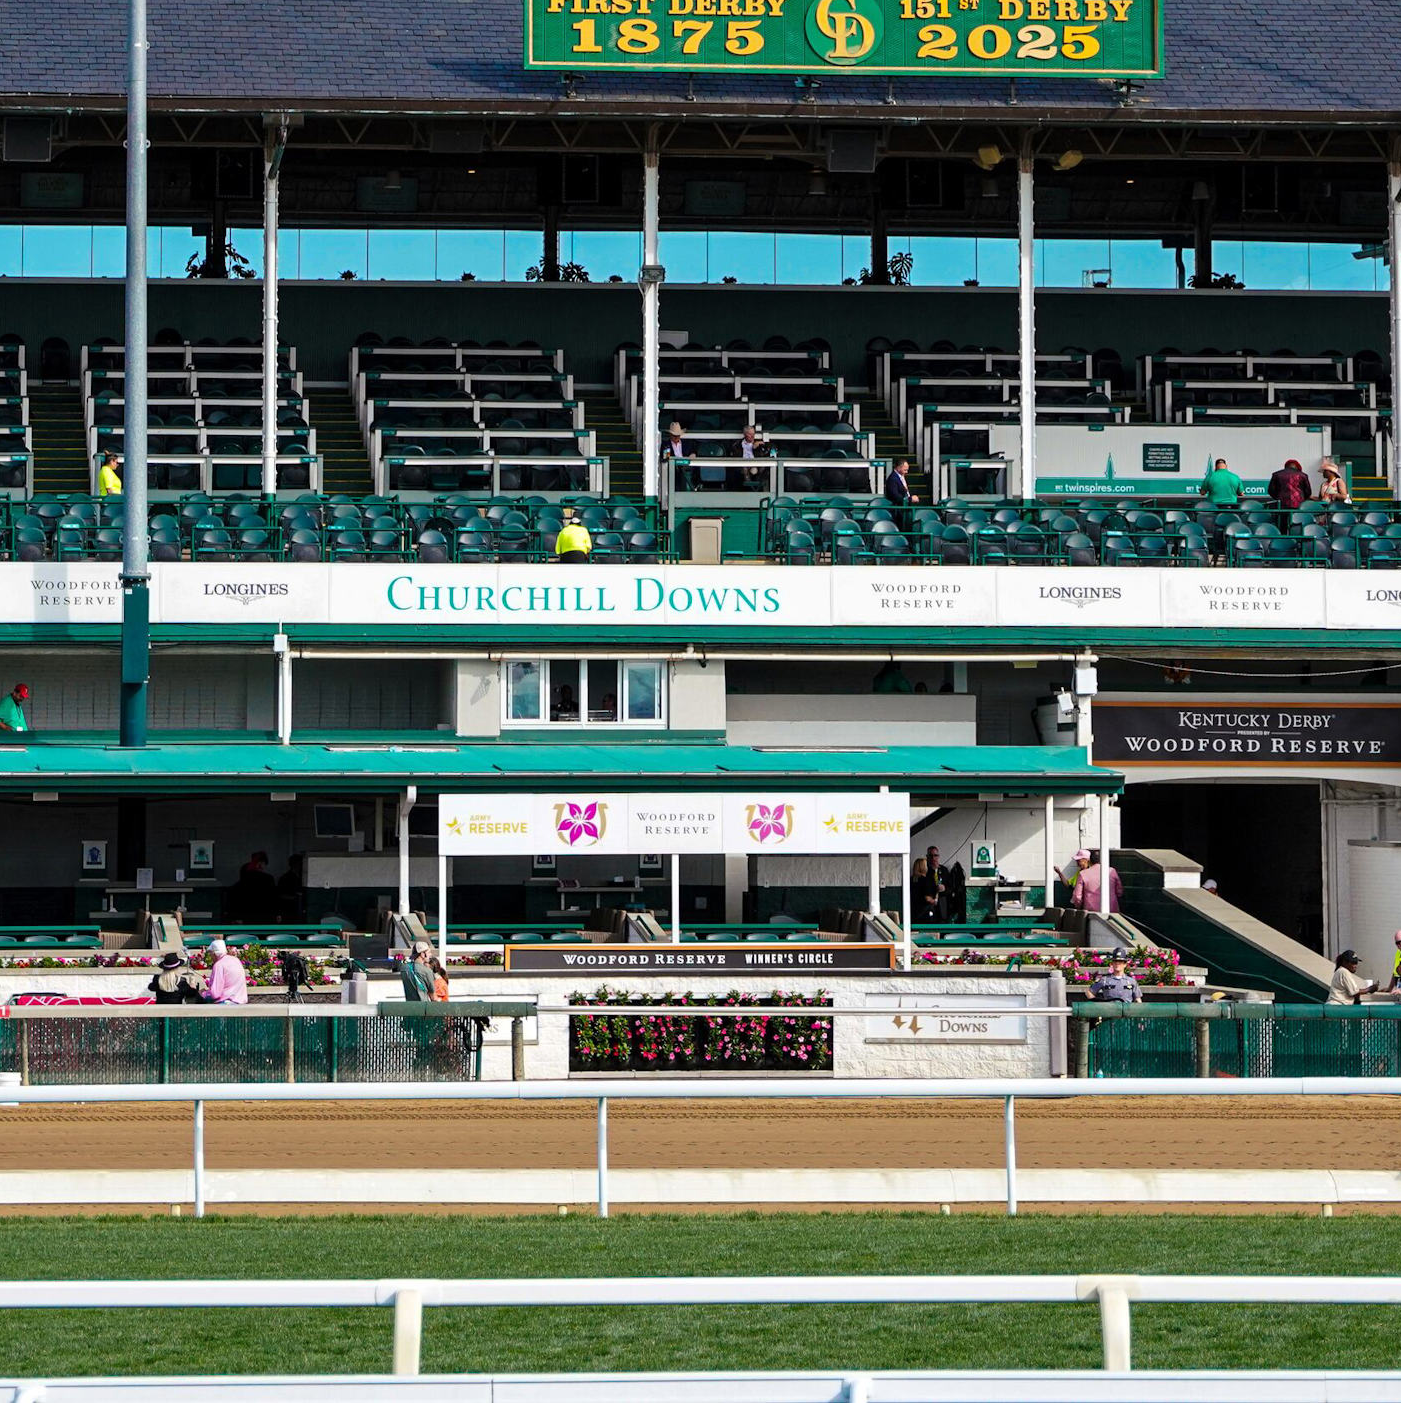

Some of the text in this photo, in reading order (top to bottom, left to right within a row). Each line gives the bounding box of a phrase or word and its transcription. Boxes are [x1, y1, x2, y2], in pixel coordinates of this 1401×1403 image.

[572, 18, 766, 55] 1875
[917, 24, 1102, 60] 2025
[1065, 482, 1135, 493] twinspires.com
[203, 583, 289, 596] LONGINES
[386, 575, 781, 613] CHURCHILL DOWNS
[871, 583, 962, 594] WOODFORD
[1038, 586, 1122, 599] LONGINES
[1199, 585, 1289, 596] WOODFORD
[39, 595, 116, 605] RESERVE
[881, 598, 954, 608] RESERVE
[1209, 600, 1282, 610] RESERVE
[1178, 712, 1331, 729] KENTUCKY DERBY
[1125, 736, 1382, 754] WOODFORD RESERVE
[636, 812, 716, 822] WOODFORD
[469, 822, 528, 834] RESERVE
[645, 825, 710, 835] RESERVE
[846, 821, 904, 832] RESERVE
[562, 953, 834, 965] WOODFORD RESERVE WINNER'S CIRCLE
[939, 1019, 988, 1033] DOWNS
